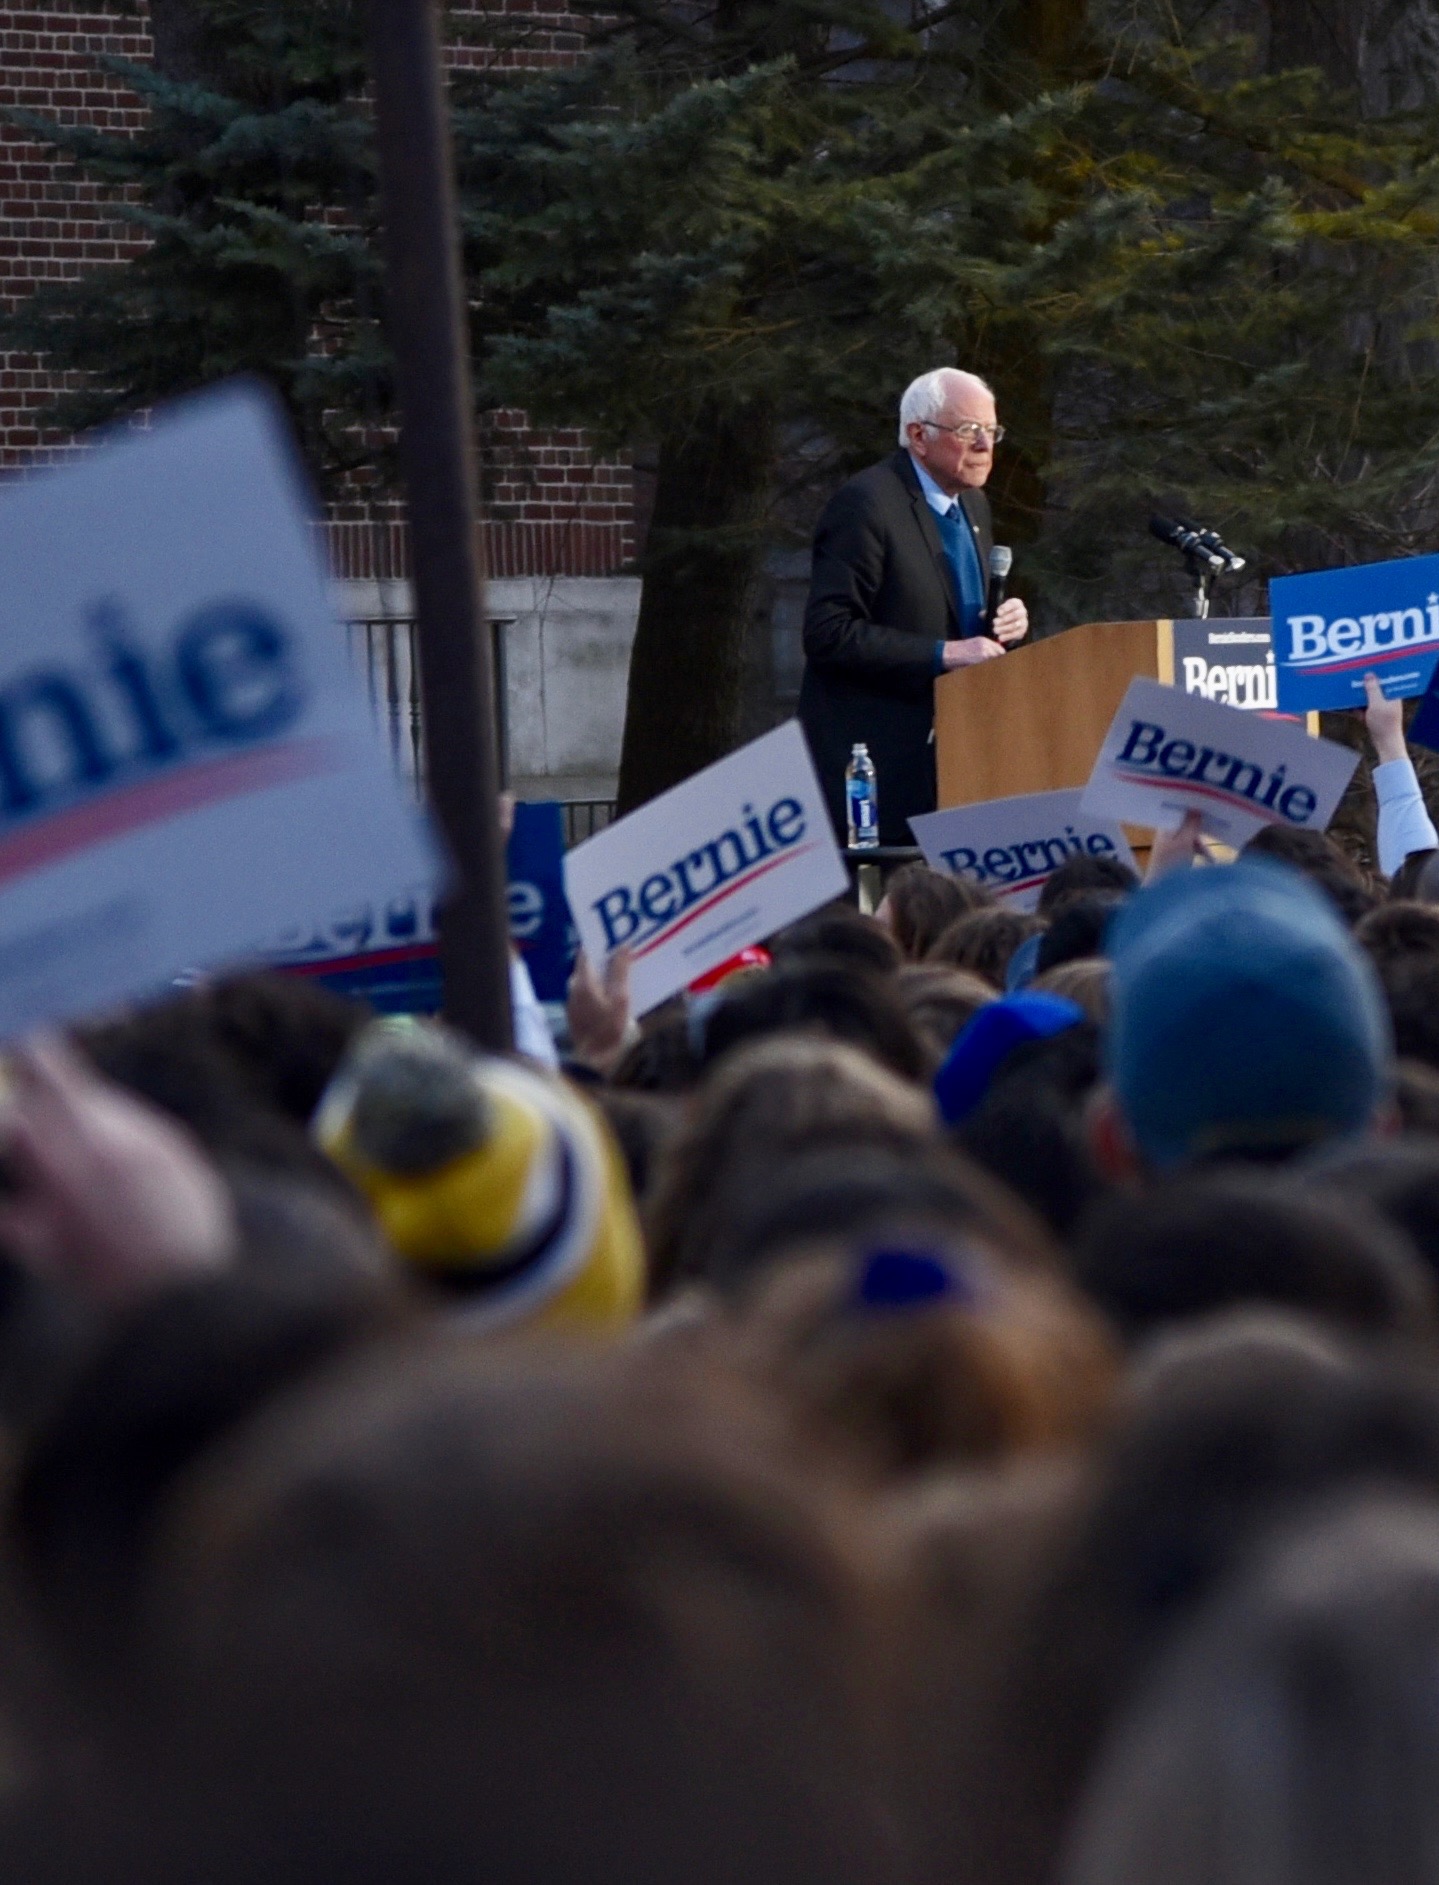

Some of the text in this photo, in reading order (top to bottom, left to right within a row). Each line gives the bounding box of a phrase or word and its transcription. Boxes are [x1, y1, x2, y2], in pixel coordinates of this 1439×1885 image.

[1182, 650, 1277, 709] Berni
[1115, 720, 1317, 823] Bernie
[591, 796, 806, 951] Bernie
